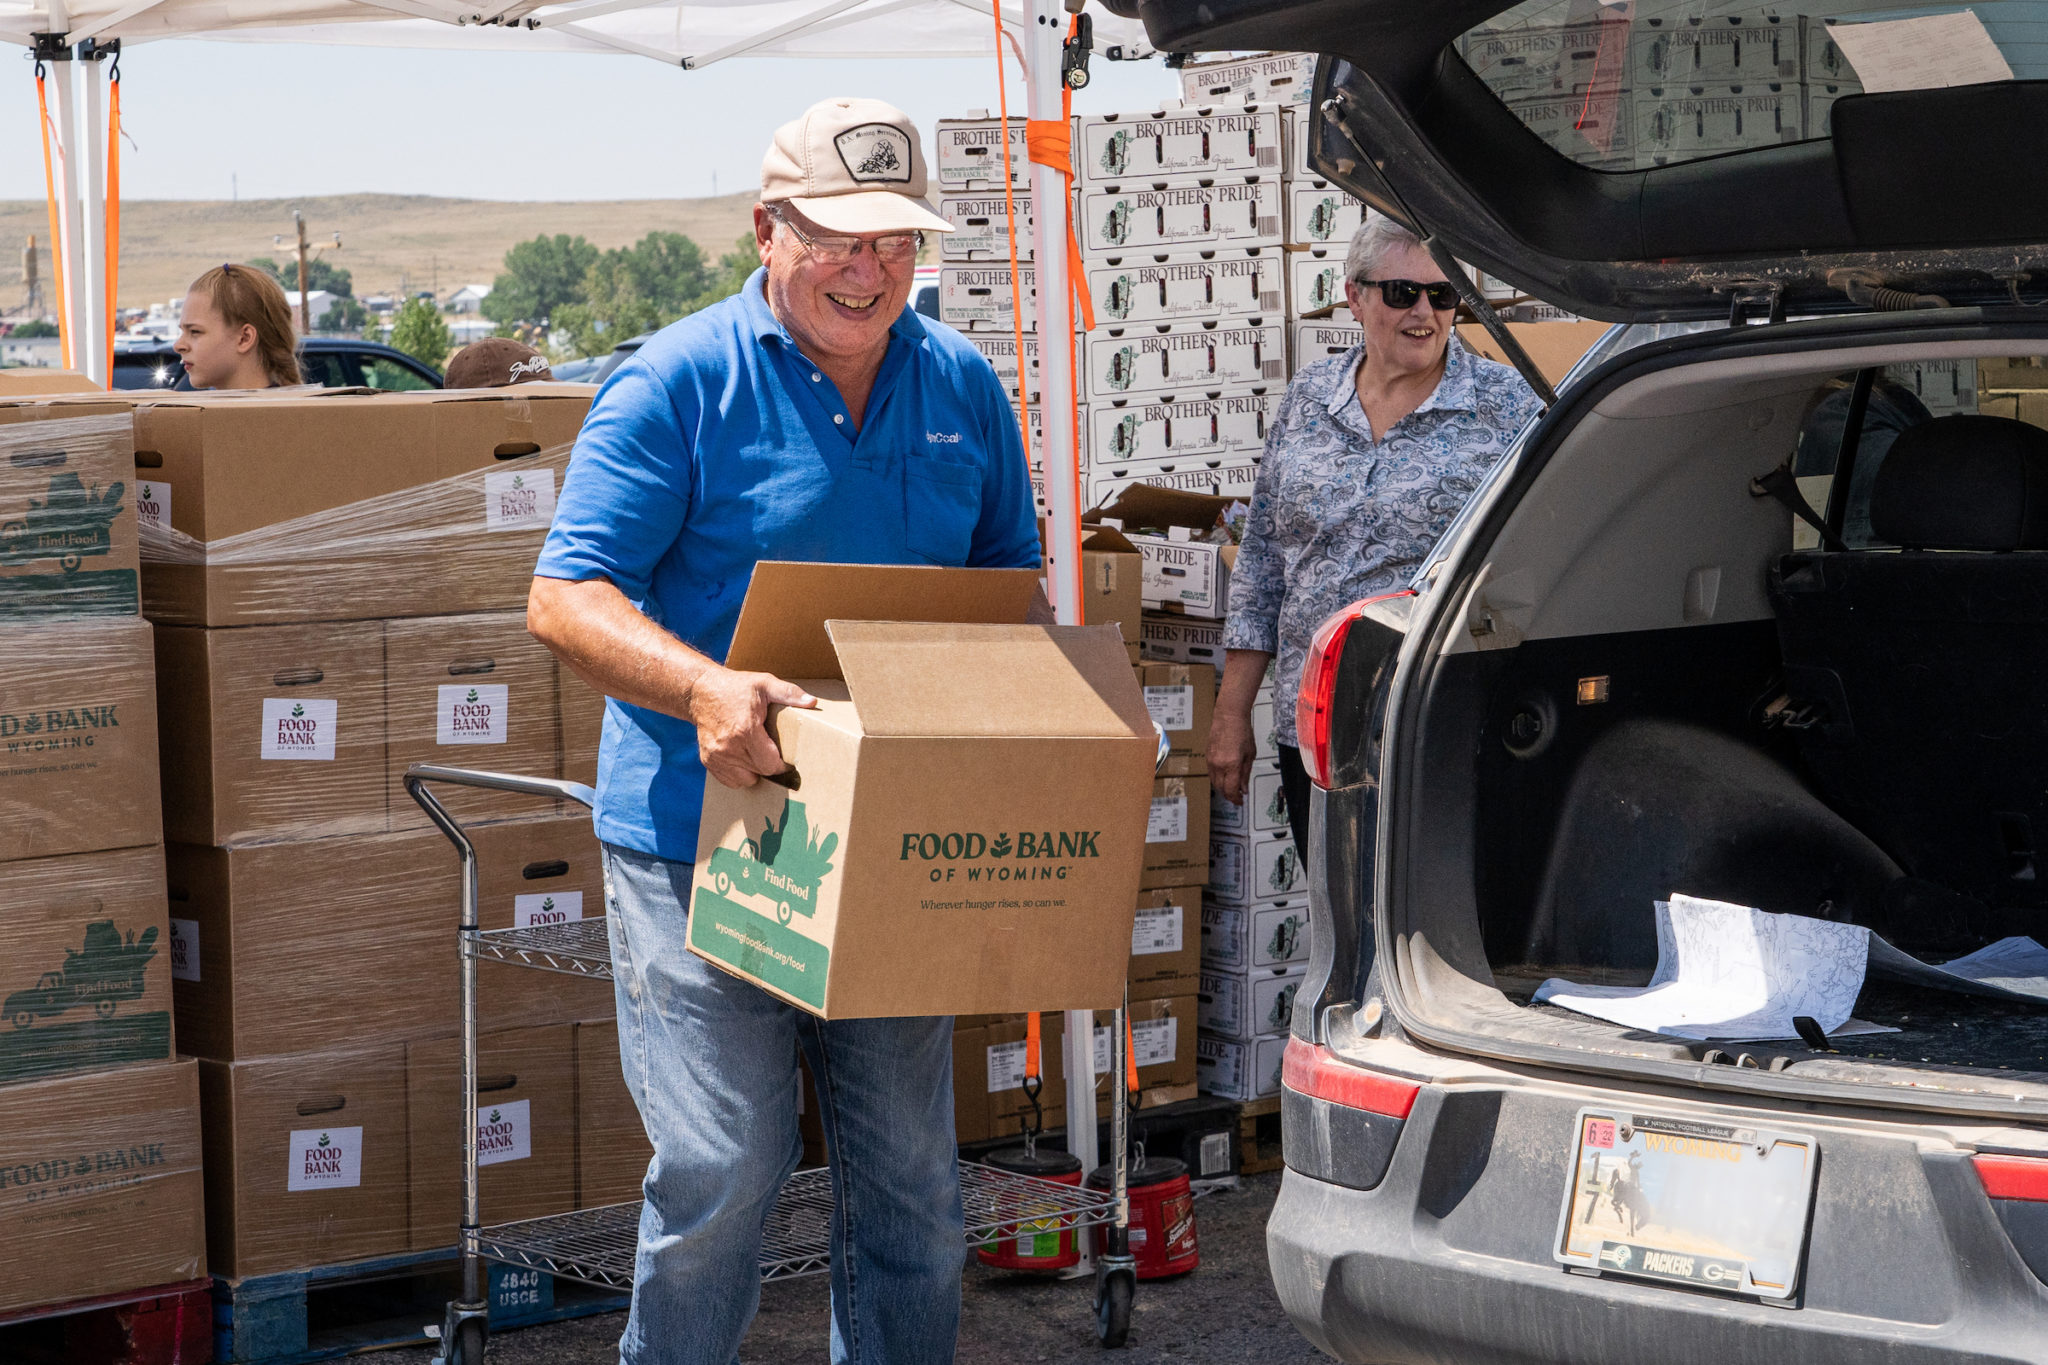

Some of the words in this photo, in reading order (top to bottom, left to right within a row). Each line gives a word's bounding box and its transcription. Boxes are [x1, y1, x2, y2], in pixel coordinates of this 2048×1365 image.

[1263, 58, 1298, 76] PRIDE
[1136, 119, 1214, 138] BROTHERS'
[1218, 116, 1261, 132] PRIDE
[1138, 189, 1215, 208] BROTHERS'
[1220, 186, 1262, 202] PRIDE
[1140, 264, 1218, 284] BROTHERS'
[1222, 260, 1264, 278] PRIDE
[1142, 333, 1220, 353] BROTHERS'
[1224, 330, 1266, 346] PRIDE
[1145, 401, 1223, 422] BROTHERS'
[1227, 397, 1269, 414] PRIDE
[68, 532, 98, 546] Food
[1156, 548, 1195, 566] PRIDE
[1184, 628, 1222, 645] PRIDE
[47, 705, 119, 732] BANK
[454, 705, 490, 717] FOOD
[278, 719, 316, 731] FOOD
[453, 718, 490, 730] BANK
[8, 736, 95, 753] WYOMING
[278, 732, 315, 744] BANK
[900, 832, 986, 860] FOOD
[1016, 832, 1101, 859] BANK
[930, 868, 956, 882] OF
[968, 866, 1068, 881] WYOMING
[764, 867, 786, 889] Find
[786, 878, 809, 901] Food
[920, 900, 964, 910] Wherever
[965, 899, 996, 912] hunger
[998, 899, 1020, 908] rises,
[530, 912, 566, 925] FOOD
[714, 921, 805, 972] wyomingfoodbank.org/food
[478, 1122, 513, 1138] FOOD
[1589, 1123, 1597, 1144] 6
[1651, 1120, 1676, 1129] NATIONAL
[1678, 1124, 1705, 1133] FOOTBALL
[1707, 1128, 1729, 1136] LEAGUE
[478, 1134, 513, 1150] BANK
[1645, 1132, 1742, 1162] WYOMING
[305, 1148, 342, 1161] FOOD
[0, 1159, 70, 1189] FOOD
[96, 1143, 166, 1172] BANK
[305, 1161, 341, 1174] BANK
[1587, 1152, 1601, 1186] 1
[1584, 1191, 1599, 1224] 7
[1643, 1252, 1694, 1277] PACKERS
[500, 1271, 538, 1289] 4840
[500, 1290, 539, 1306] USCE
